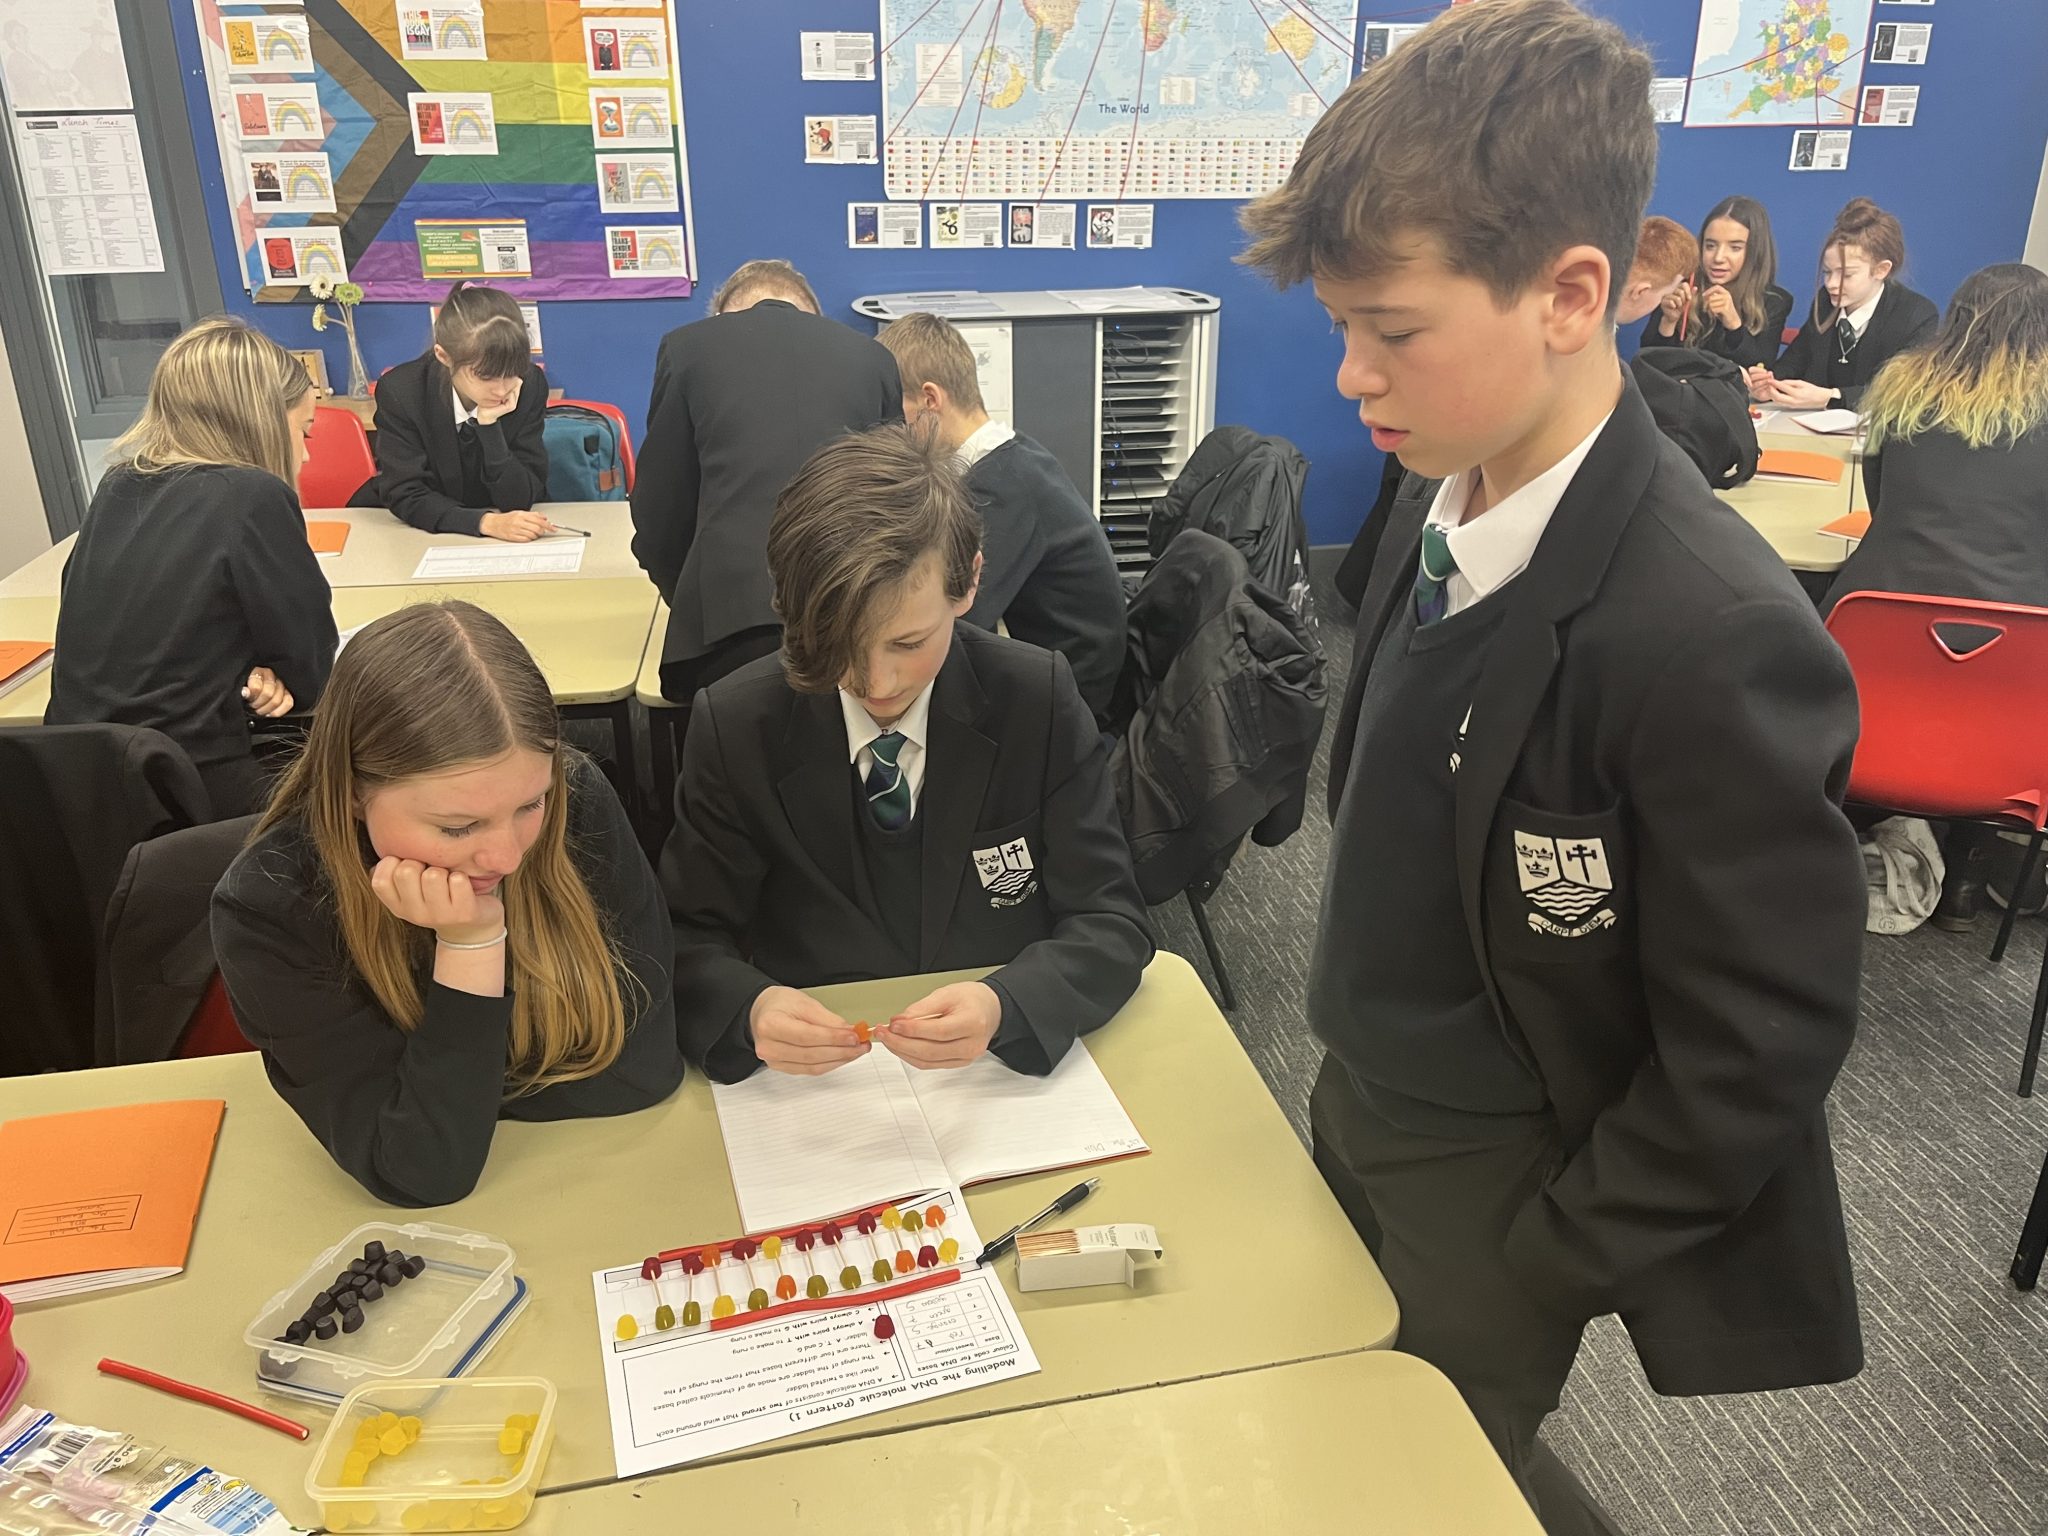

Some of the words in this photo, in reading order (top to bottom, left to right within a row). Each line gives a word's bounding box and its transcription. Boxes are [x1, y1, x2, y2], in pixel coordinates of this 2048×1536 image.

[1098, 103, 1117, 114] The
[1120, 103, 1150, 114] World
[62, 117, 88, 126] Lunch
[830, 1311, 852, 1320] always
[929, 1306, 951, 1318] green
[832, 1321, 855, 1331] always
[754, 1330, 772, 1338] make
[812, 1328, 830, 1336] pairs
[794, 1333, 810, 1341] with
[756, 1341, 774, 1350] make
[850, 1342, 871, 1351] There
[992, 1344, 1014, 1353] Colour
[974, 1350, 990, 1358] code
[784, 1354, 818, 1368] different
[840, 1357, 860, 1365] rungs
[940, 1358, 958, 1366] DNA
[762, 1364, 782, 1372] bases
[860, 1366, 879, 1374] other
[918, 1364, 938, 1372] bases
[964, 1358, 1015, 1376] Modelling
[725, 1373, 743, 1381] form
[745, 1369, 760, 1377] that
[792, 1368, 815, 1378] ladder
[942, 1372, 961, 1381] the
[688, 1381, 708, 1390] rungs
[757, 1378, 776, 1386] made
[810, 1376, 837, 1387] twisted
[858, 1378, 876, 1388] DNA
[911, 1378, 938, 1390] DNA
[786, 1384, 808, 1393] ladder
[826, 1384, 856, 1395] molecule
[700, 1388, 735, 1401] chemicals
[795, 1391, 824, 1402] consists
[859, 1386, 906, 1403] molecule
[676, 1396, 698, 1406] called
[653, 1402, 674, 1412] bases
[741, 1405, 766, 1416] strand
[806, 1398, 854, 1416] (Pattern
[704, 1417, 720, 1426] wind
[722, 1413, 739, 1421] that
[789, 1413, 800, 1422] 1)
[676, 1422, 701, 1433] around
[656, 1429, 674, 1438] each
